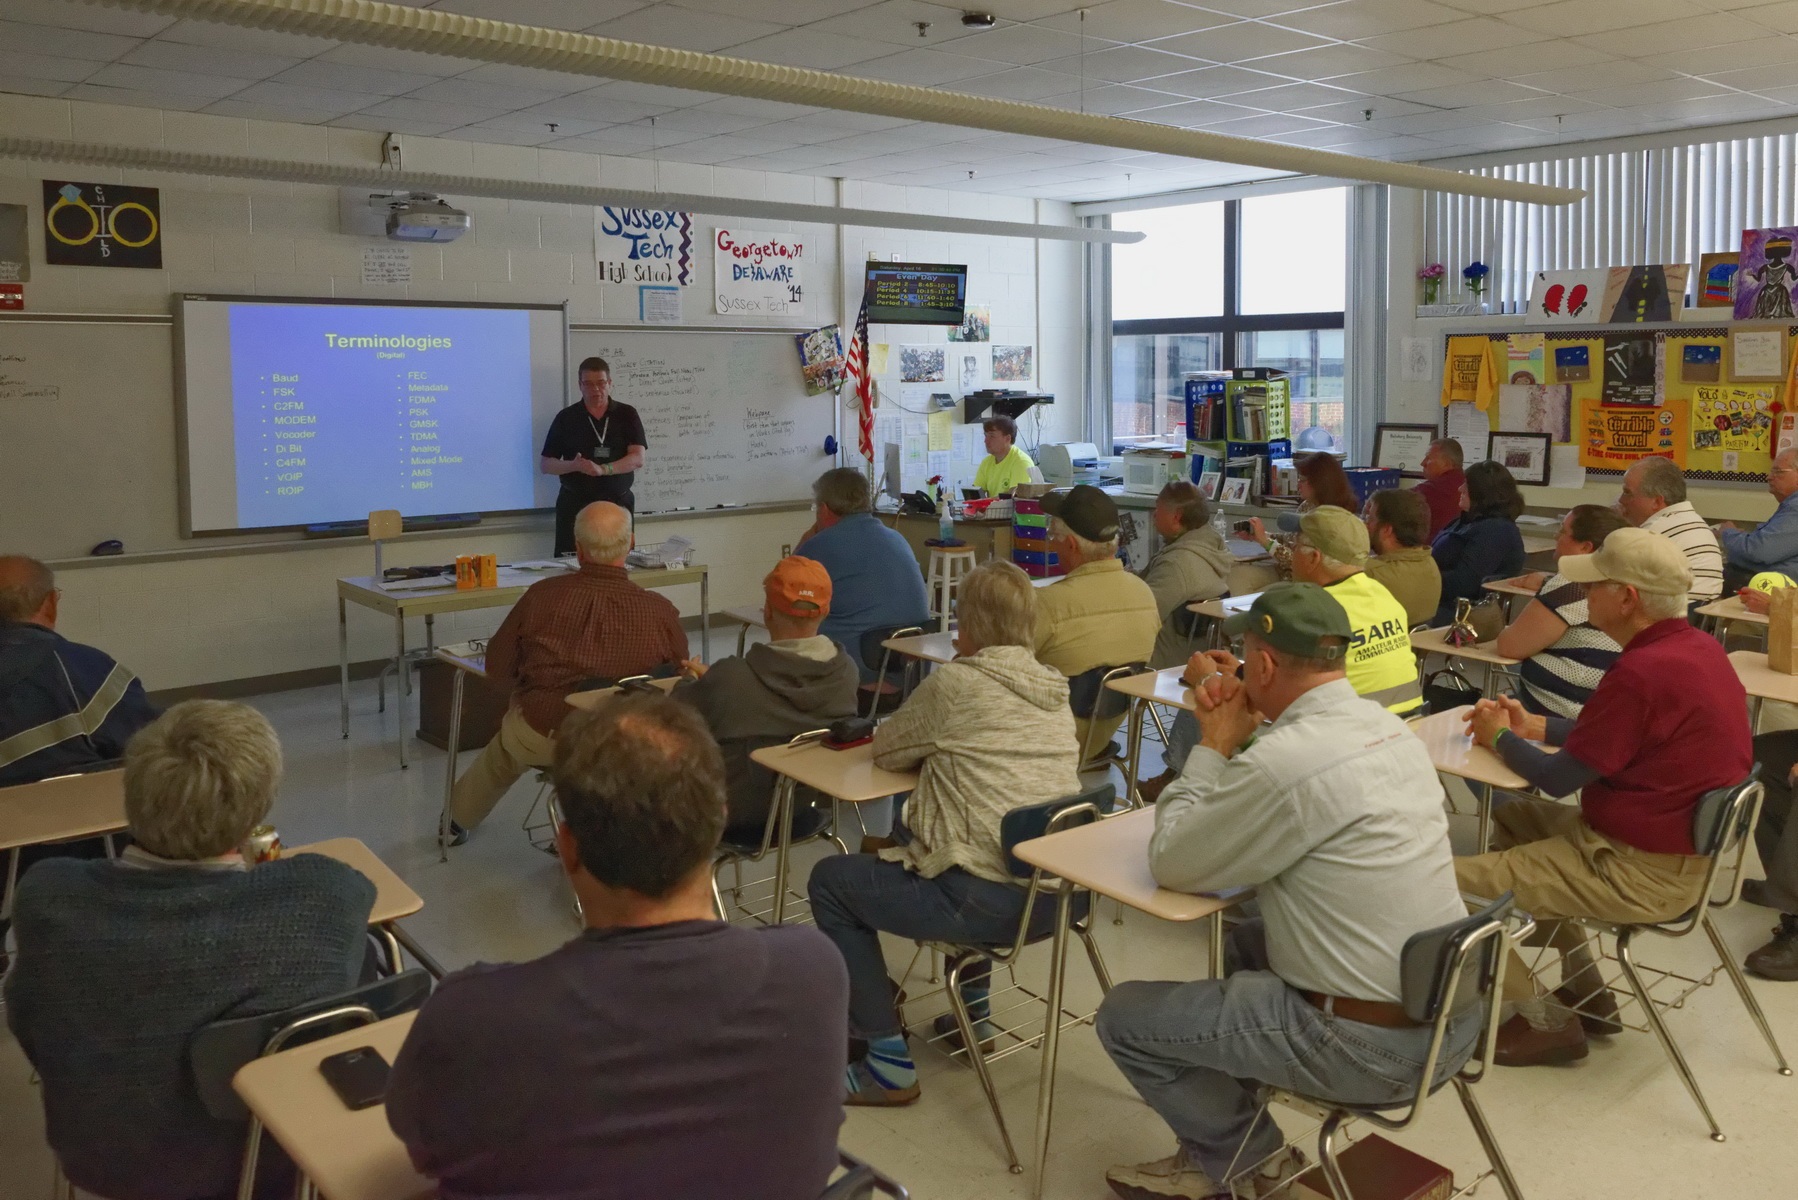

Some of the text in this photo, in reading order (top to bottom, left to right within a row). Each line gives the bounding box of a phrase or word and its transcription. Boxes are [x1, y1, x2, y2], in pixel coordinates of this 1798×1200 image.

[622, 231, 673, 260] Tech
[717, 230, 803, 264] Georgetown
[599, 261, 672, 284] High School
[920, 274, 938, 282] Day
[718, 294, 789, 313] Sussex Tech
[325, 333, 452, 351] Terminologies
[376, 351, 405, 359] (Digital)
[272, 373, 299, 382] Baud
[408, 371, 427, 380] FEC
[273, 387, 295, 396] FSK
[408, 384, 449, 392] Metadata
[1697, 389, 1717, 400] YOLO
[408, 396, 436, 404] FDMA
[274, 401, 304, 410] C2FM
[409, 408, 429, 416] PSK
[274, 415, 316, 425] MODEM
[409, 420, 438, 428] GMSK
[1608, 416, 1655, 431] terrible
[275, 430, 316, 439] Vocoder
[1612, 431, 1648, 447] towel
[289, 444, 302, 452] Bit
[410, 445, 441, 454] Analog
[276, 458, 306, 467] C4FM
[411, 457, 436, 465] Mixed
[277, 472, 303, 481] VOIP
[411, 469, 432, 477] AMS
[277, 486, 304, 495] ROIP
[1351, 618, 1404, 649] SARA
[1356, 639, 1393, 656] AMATEUR
